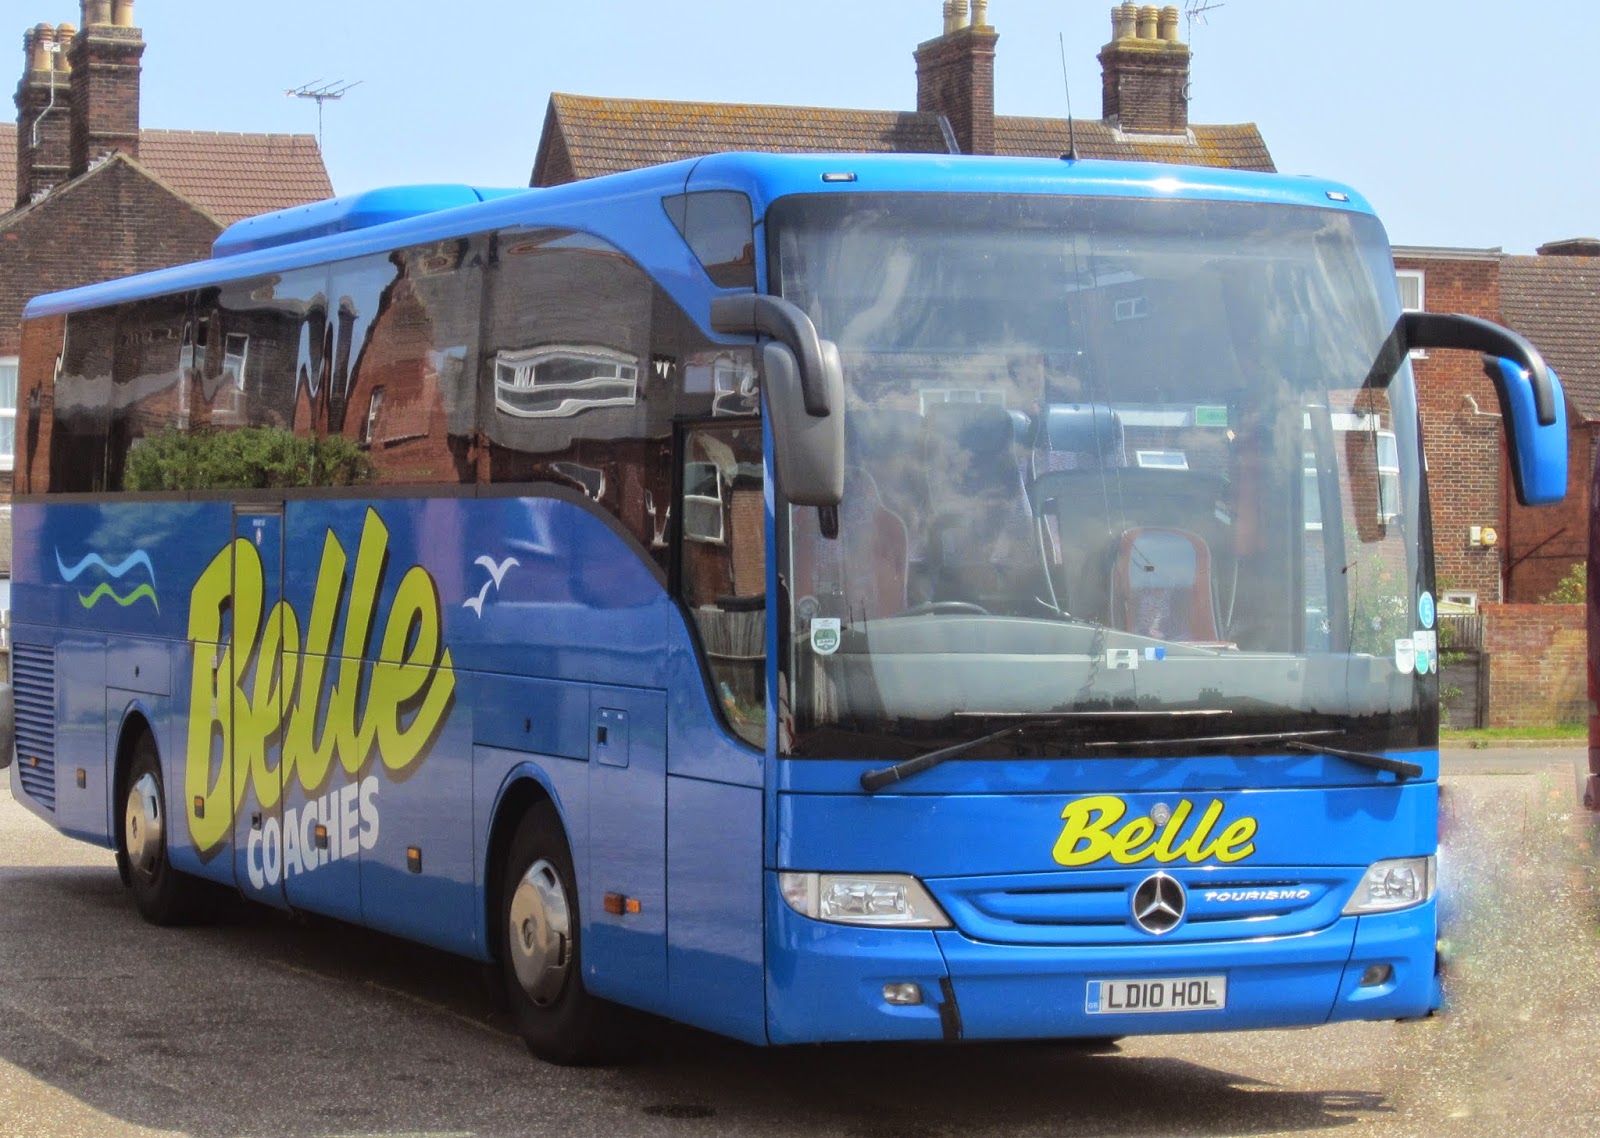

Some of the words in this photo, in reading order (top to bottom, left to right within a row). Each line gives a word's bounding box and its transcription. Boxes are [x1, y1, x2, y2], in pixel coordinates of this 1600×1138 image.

[185, 506, 457, 854] Belle
[247, 776, 379, 890] COACHES
[1052, 795, 1257, 866] Belle
[1205, 890, 1310, 902] TOURISMO
[1172, 981, 1217, 1006] HOL
